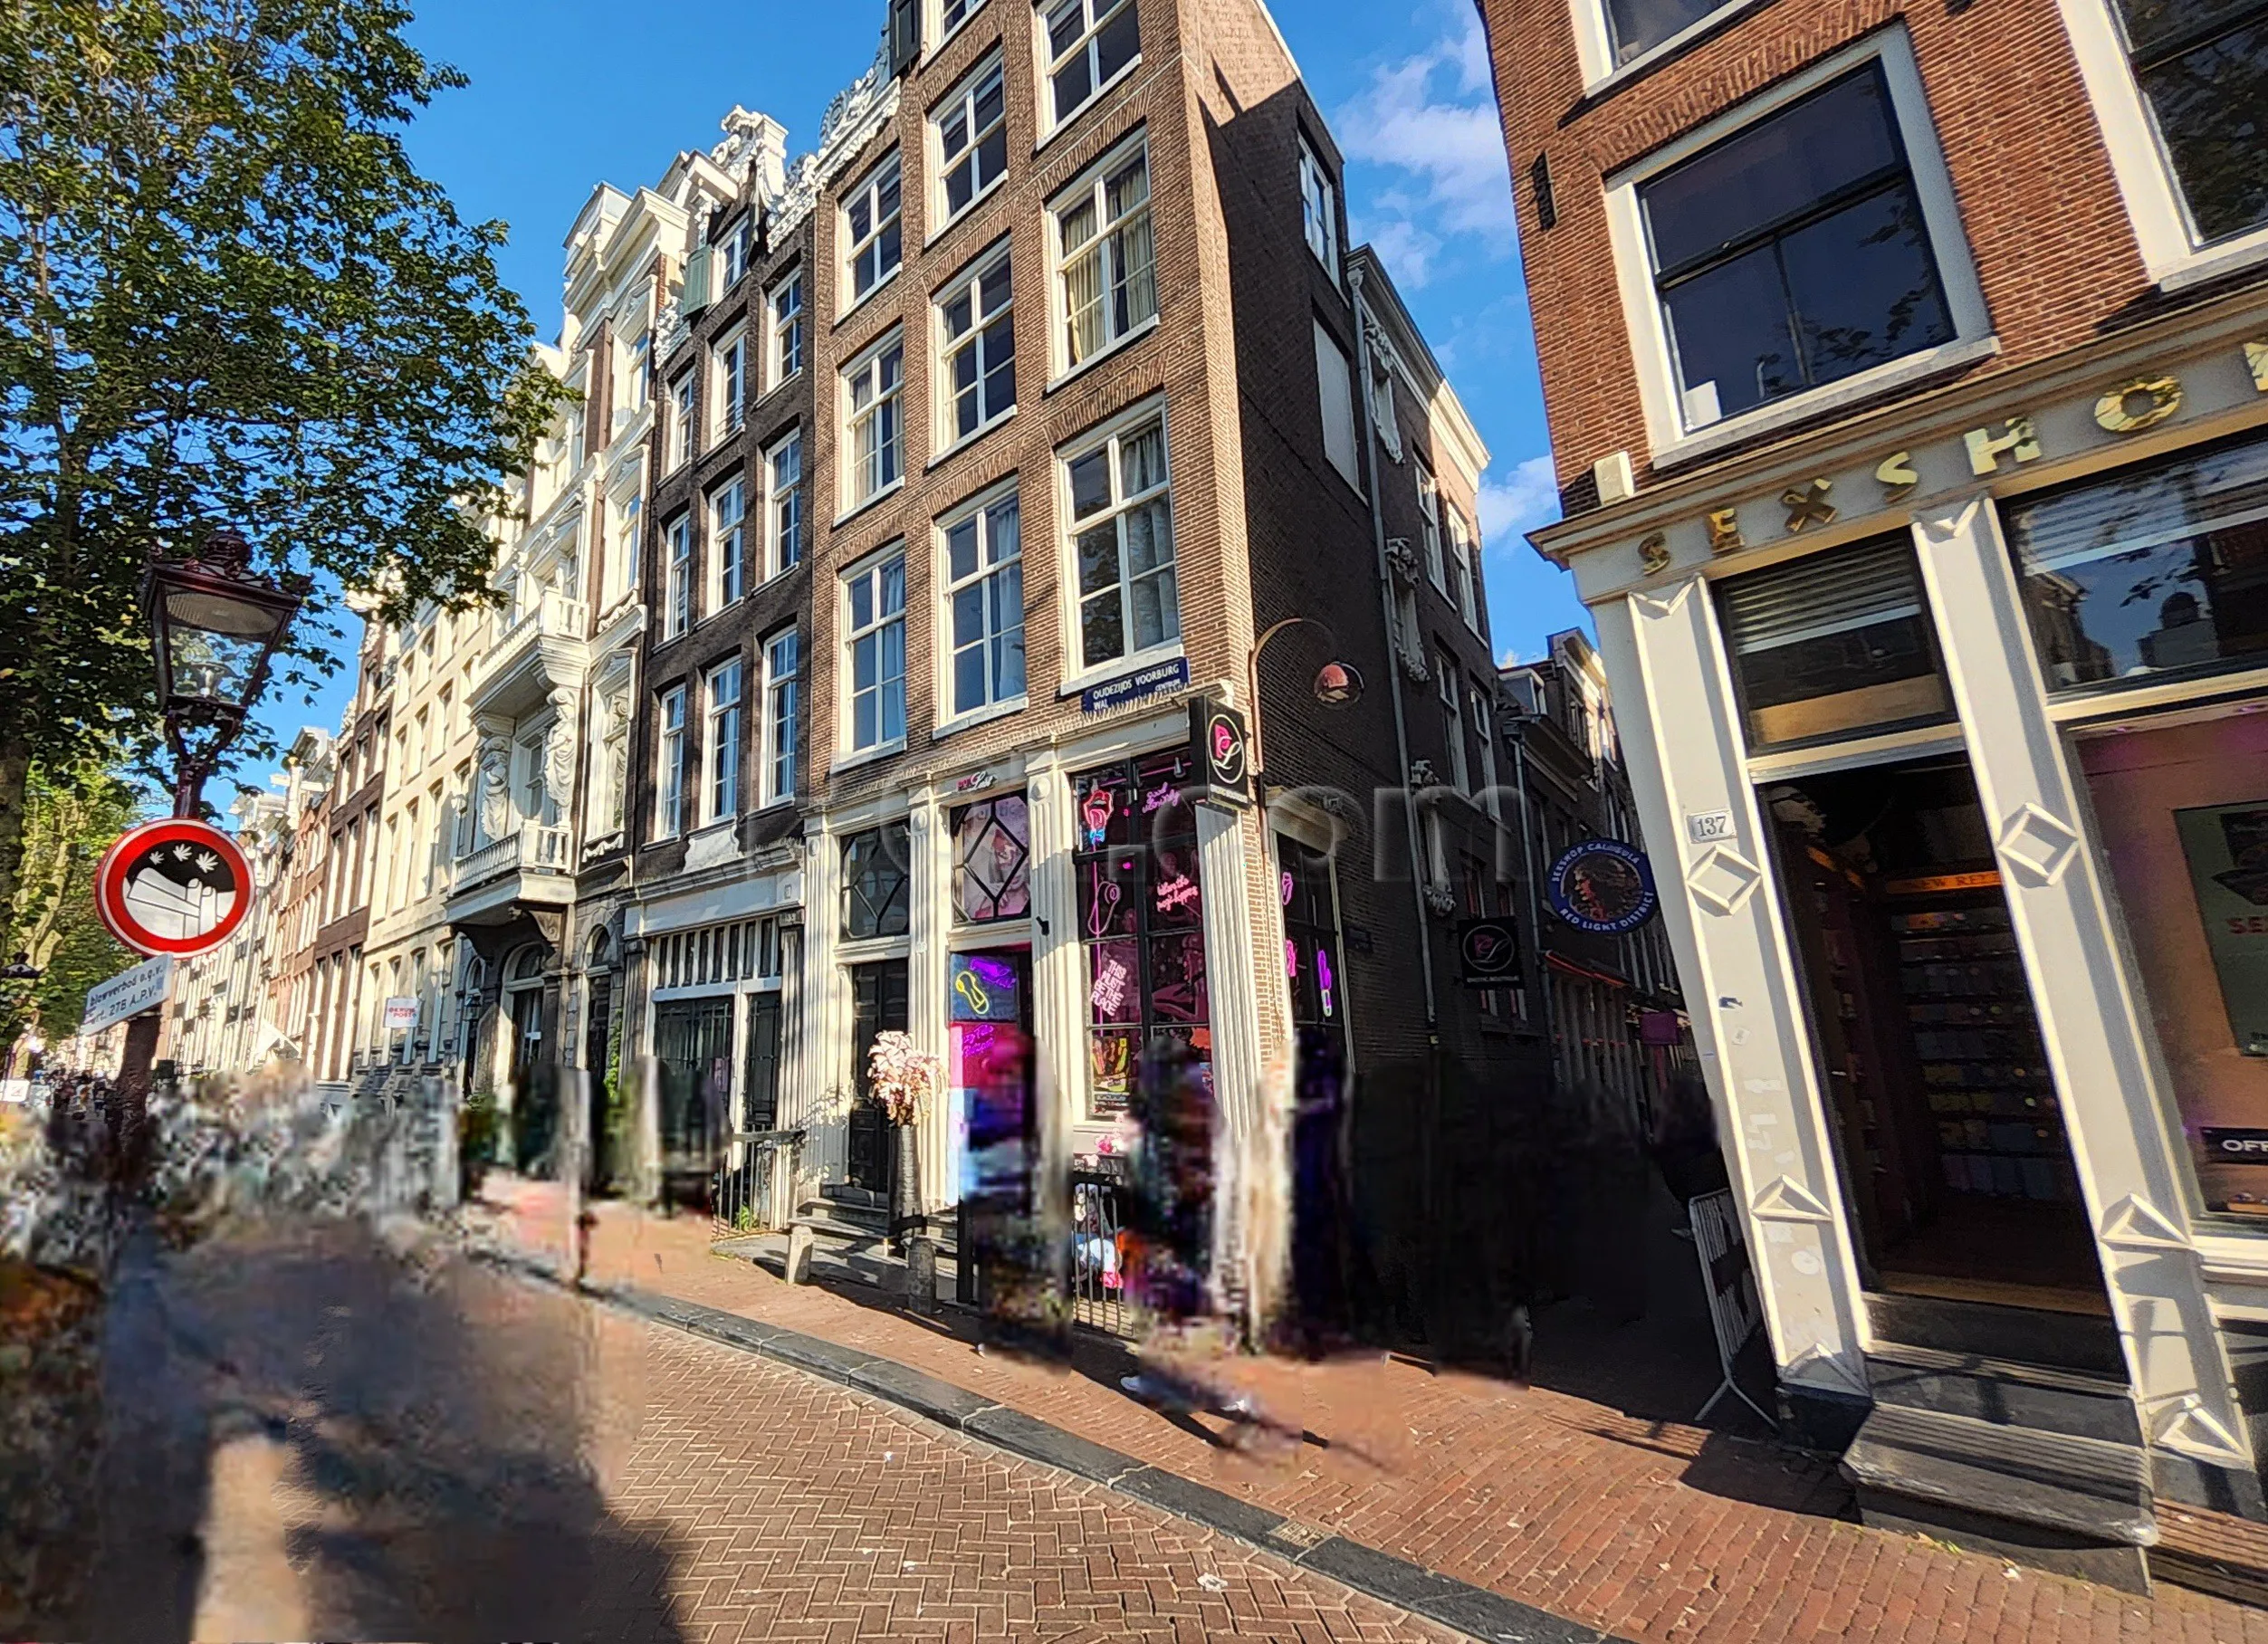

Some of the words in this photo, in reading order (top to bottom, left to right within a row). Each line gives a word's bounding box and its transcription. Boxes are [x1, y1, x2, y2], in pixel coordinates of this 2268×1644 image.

[1093, 679, 1133, 700] OUDEZIJDS
[1135, 664, 1180, 686] VOORBURG
[1094, 699, 1110, 710] WAL
[1696, 816, 1727, 836] 137
[1559, 908, 1581, 924] RED
[1582, 920, 1617, 932] LIGHT
[1618, 891, 1655, 928] DISTRICT
[2225, 915, 2268, 934] SE
